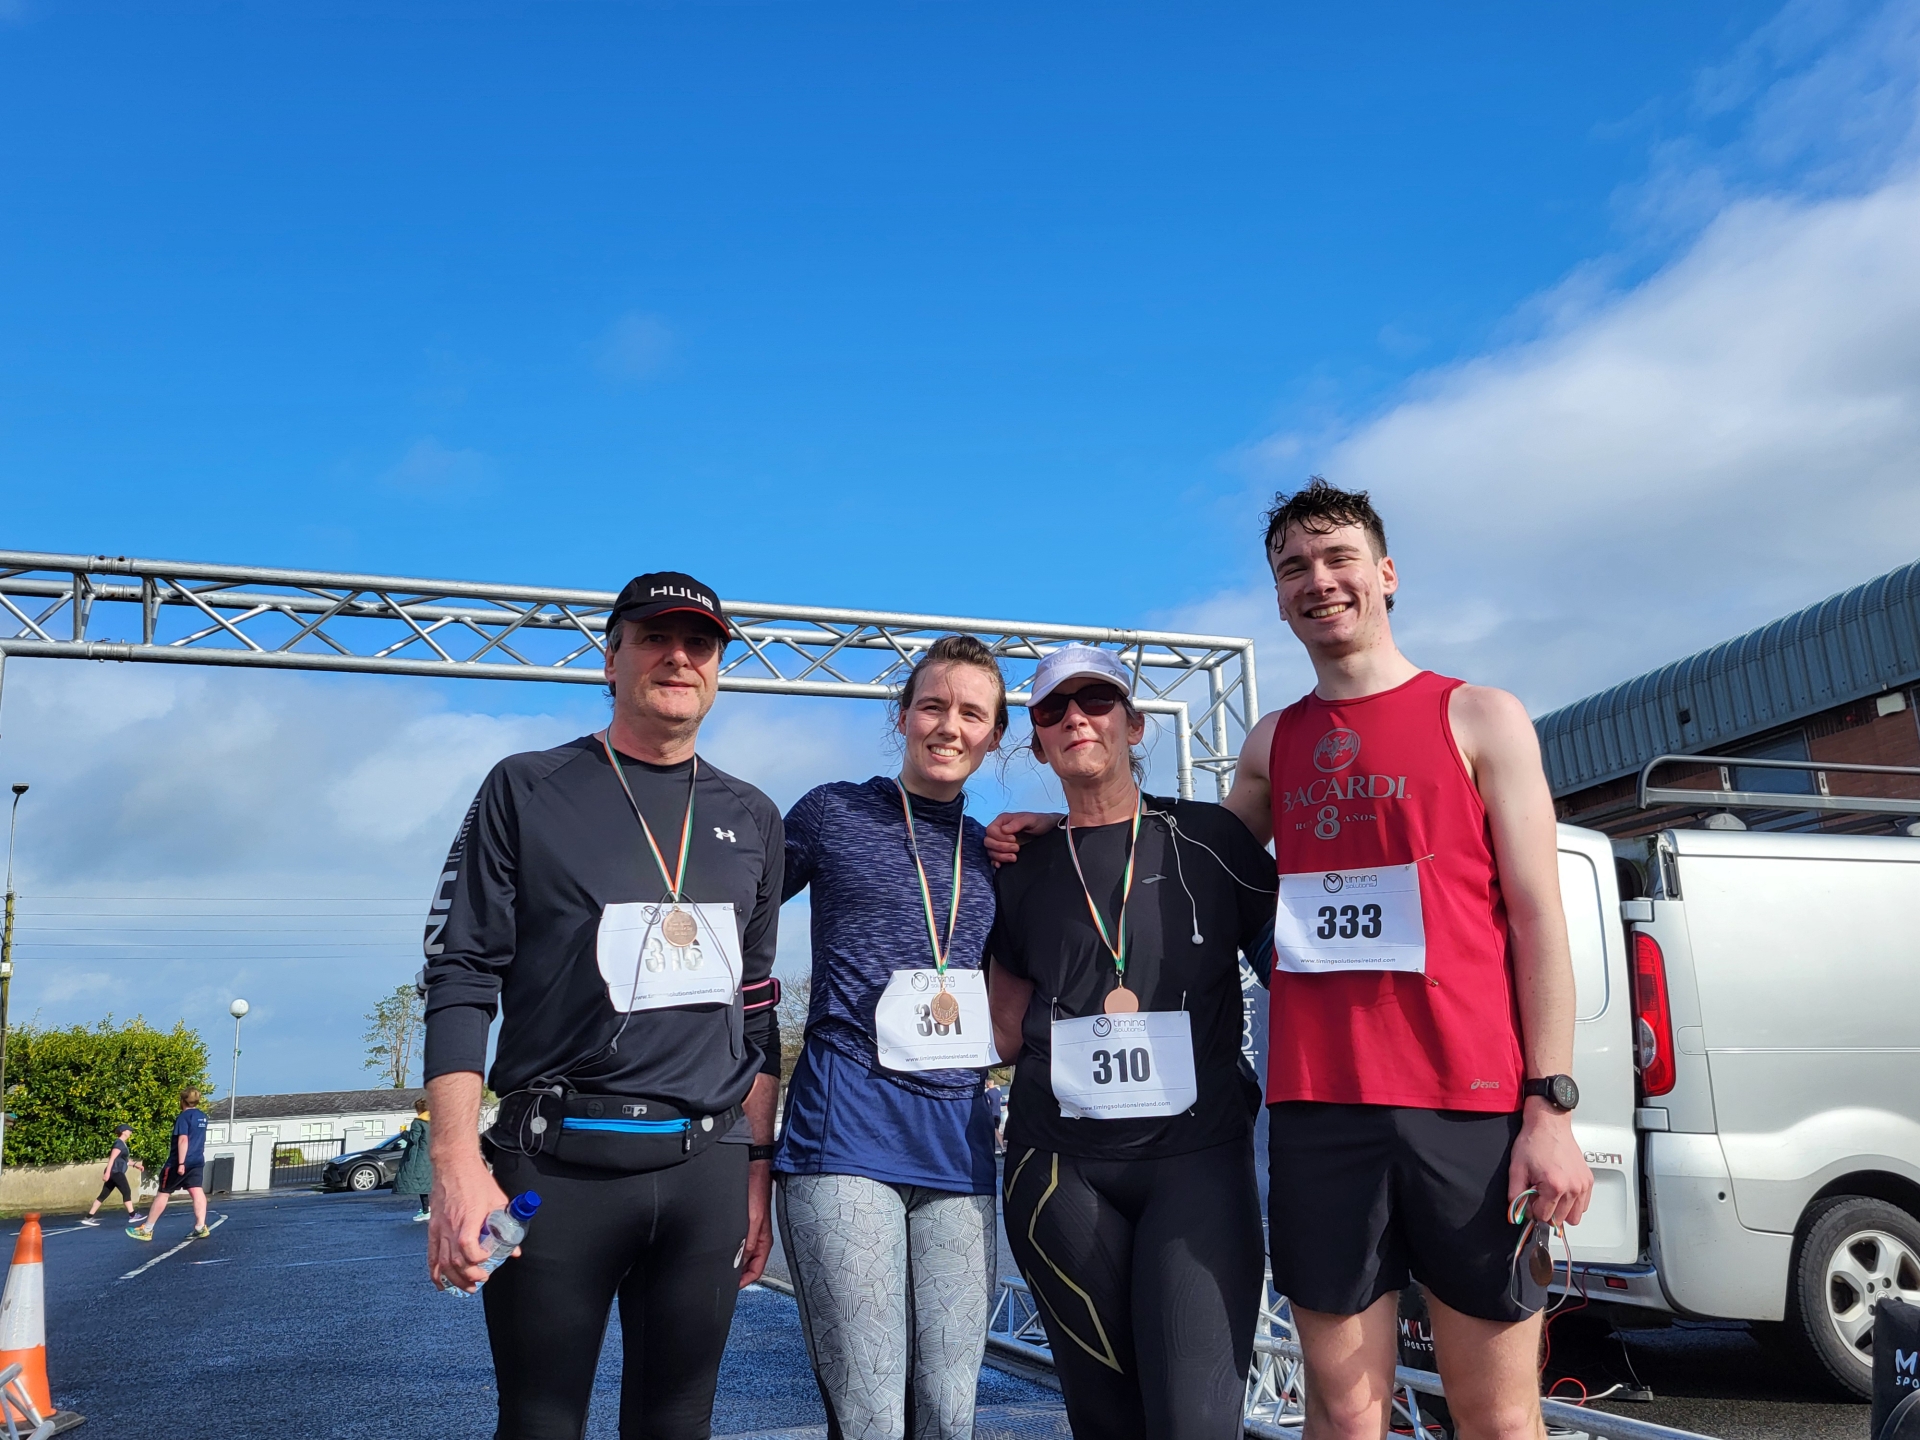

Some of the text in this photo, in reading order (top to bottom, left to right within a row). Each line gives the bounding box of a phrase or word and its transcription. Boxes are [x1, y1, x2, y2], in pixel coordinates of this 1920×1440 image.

[650, 585, 714, 612] HUUB
[1283, 774, 1407, 813] BACARDI
[1314, 805, 1341, 840] 8
[1343, 812, 1377, 823] AÑOS
[1344, 873, 1378, 887] timing
[1316, 903, 1382, 940] 333
[1113, 1018, 1146, 1032] timing
[1113, 1026, 1143, 1034] solutions
[1092, 1046, 1151, 1085] 310
[1583, 1151, 1623, 1165] CDTI
